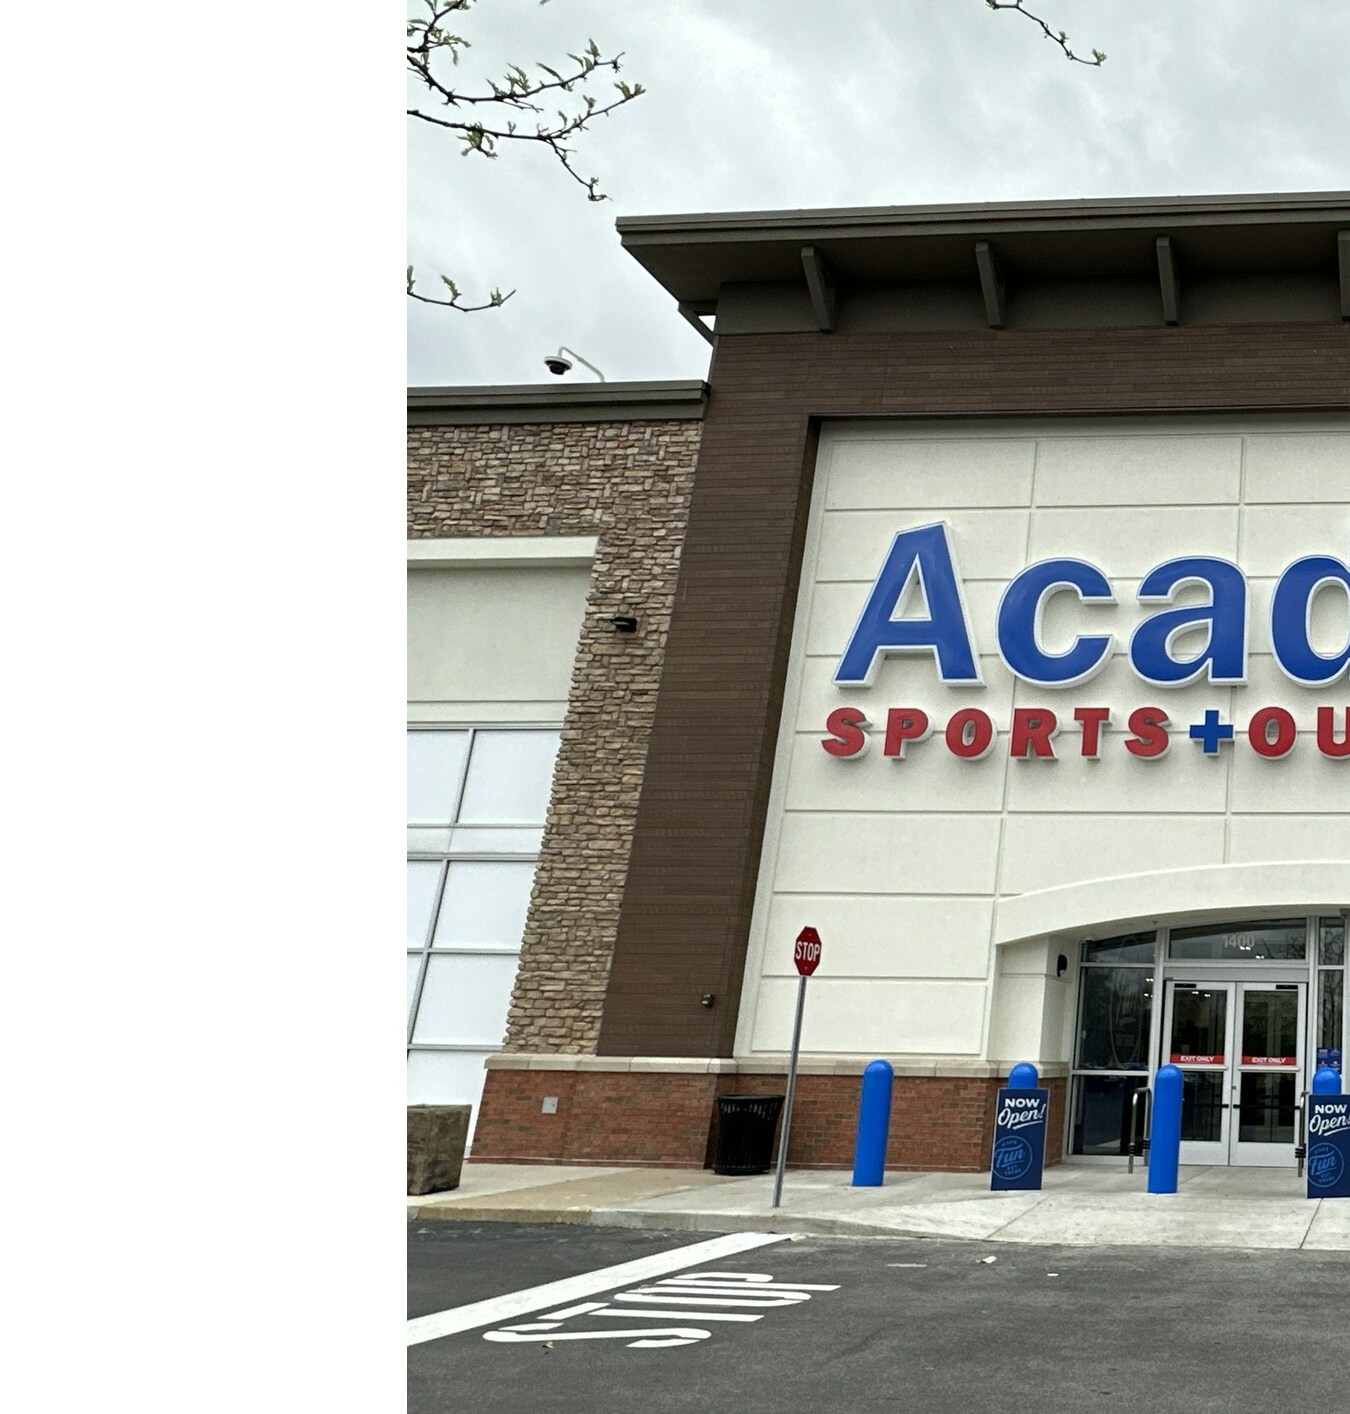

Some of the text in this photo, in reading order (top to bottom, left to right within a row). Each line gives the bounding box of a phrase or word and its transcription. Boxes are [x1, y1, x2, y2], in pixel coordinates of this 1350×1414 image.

[795, 940, 820, 962] STOP
[1222, 934, 1256, 948] 1400
[1005, 1098, 1040, 1108] NOW
[1314, 1104, 1348, 1114] NOW
[998, 1103, 1046, 1129] Open!
[995, 1143, 1025, 1169] Fun
[1309, 1150, 1337, 1176] Fun
[482, 1270, 842, 1349] STOP
